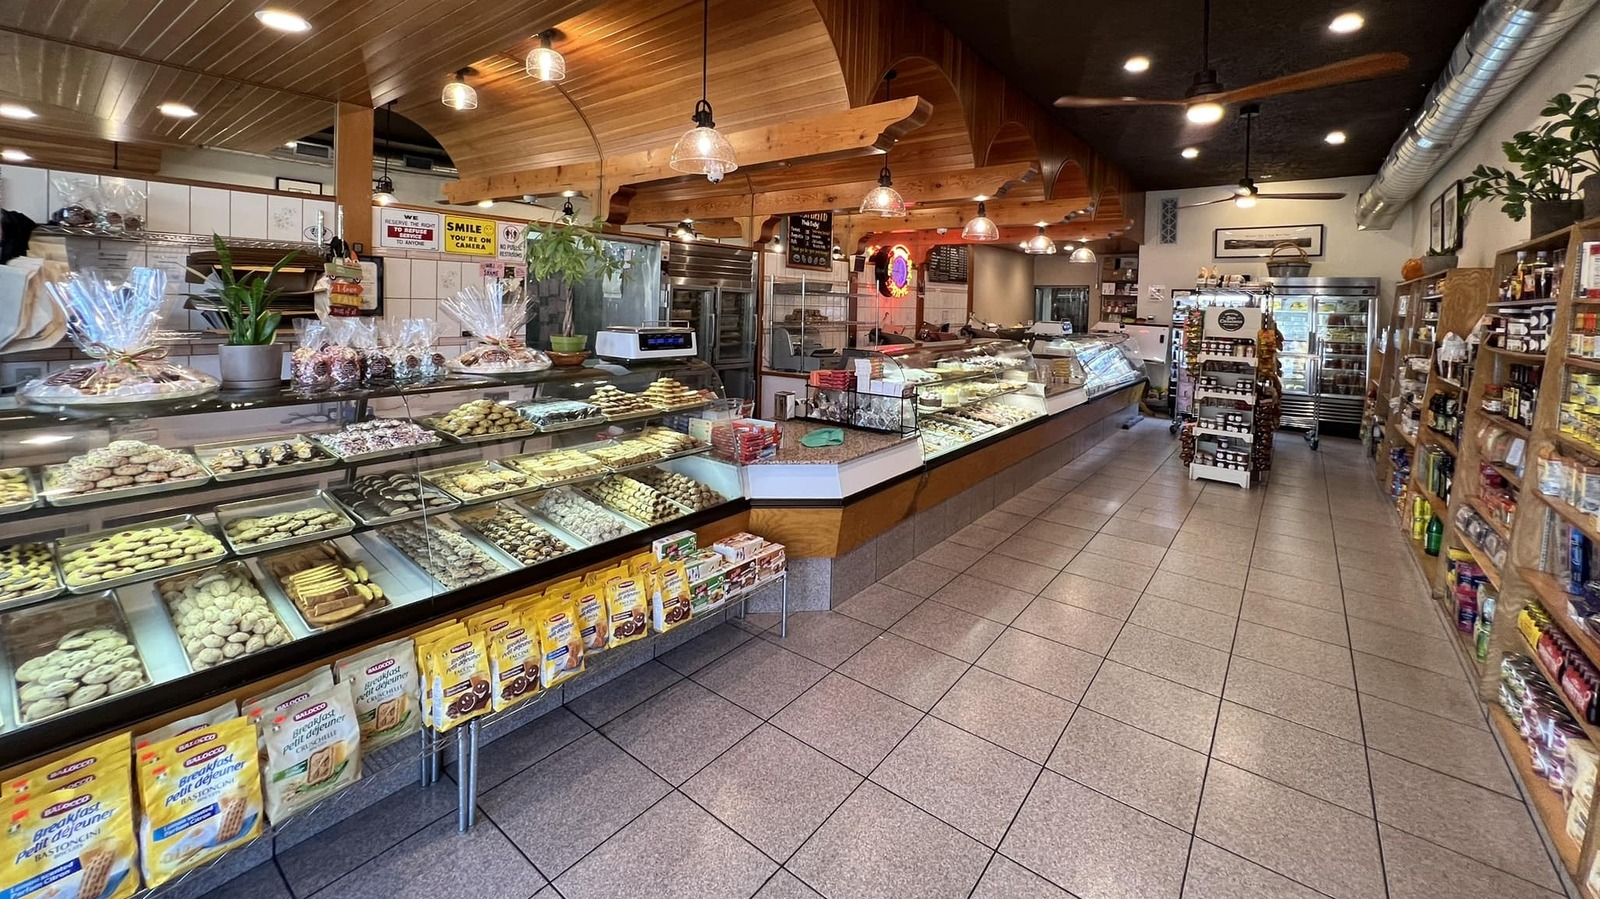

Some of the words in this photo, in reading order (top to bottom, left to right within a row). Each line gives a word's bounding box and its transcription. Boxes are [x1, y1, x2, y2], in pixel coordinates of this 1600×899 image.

[446, 222, 482, 234] SMILE
[450, 234, 477, 242] YOU'RE
[455, 242, 486, 250] CAMERA
[367, 660, 394, 674] BALOCCO
[450, 649, 475, 665] Breakfast
[364, 666, 401, 691] Breakfast
[277, 693, 308, 711] BALOCCO
[356, 687, 374, 704] Petit
[294, 702, 326, 720] BALOCCO
[283, 734, 304, 756] Petit
[305, 714, 346, 739] déjeuner
[292, 709, 335, 740] Breakfast
[178, 733, 216, 752] BALOCCO
[295, 730, 337, 754] CRUSCHELLE
[186, 746, 225, 766] BALOCCO
[50, 758, 94, 779] BALOCCO
[178, 753, 234, 788] Breakfast
[165, 782, 192, 807] Petit
[194, 761, 245, 790] déjeuner
[180, 779, 235, 805] BASTONCINI
[44, 795, 89, 817] BALOCCO
[33, 802, 101, 843] Breakfast
[189, 813, 212, 826] Citron
[15, 837, 49, 865] Petit
[51, 808, 115, 843] déjeuner
[34, 828, 102, 862] BASTONCINI
[10, 877, 40, 894] Lemon
[40, 861, 74, 880] scented
[10, 882, 43, 899] Parfum
[43, 869, 71, 884] Citron
